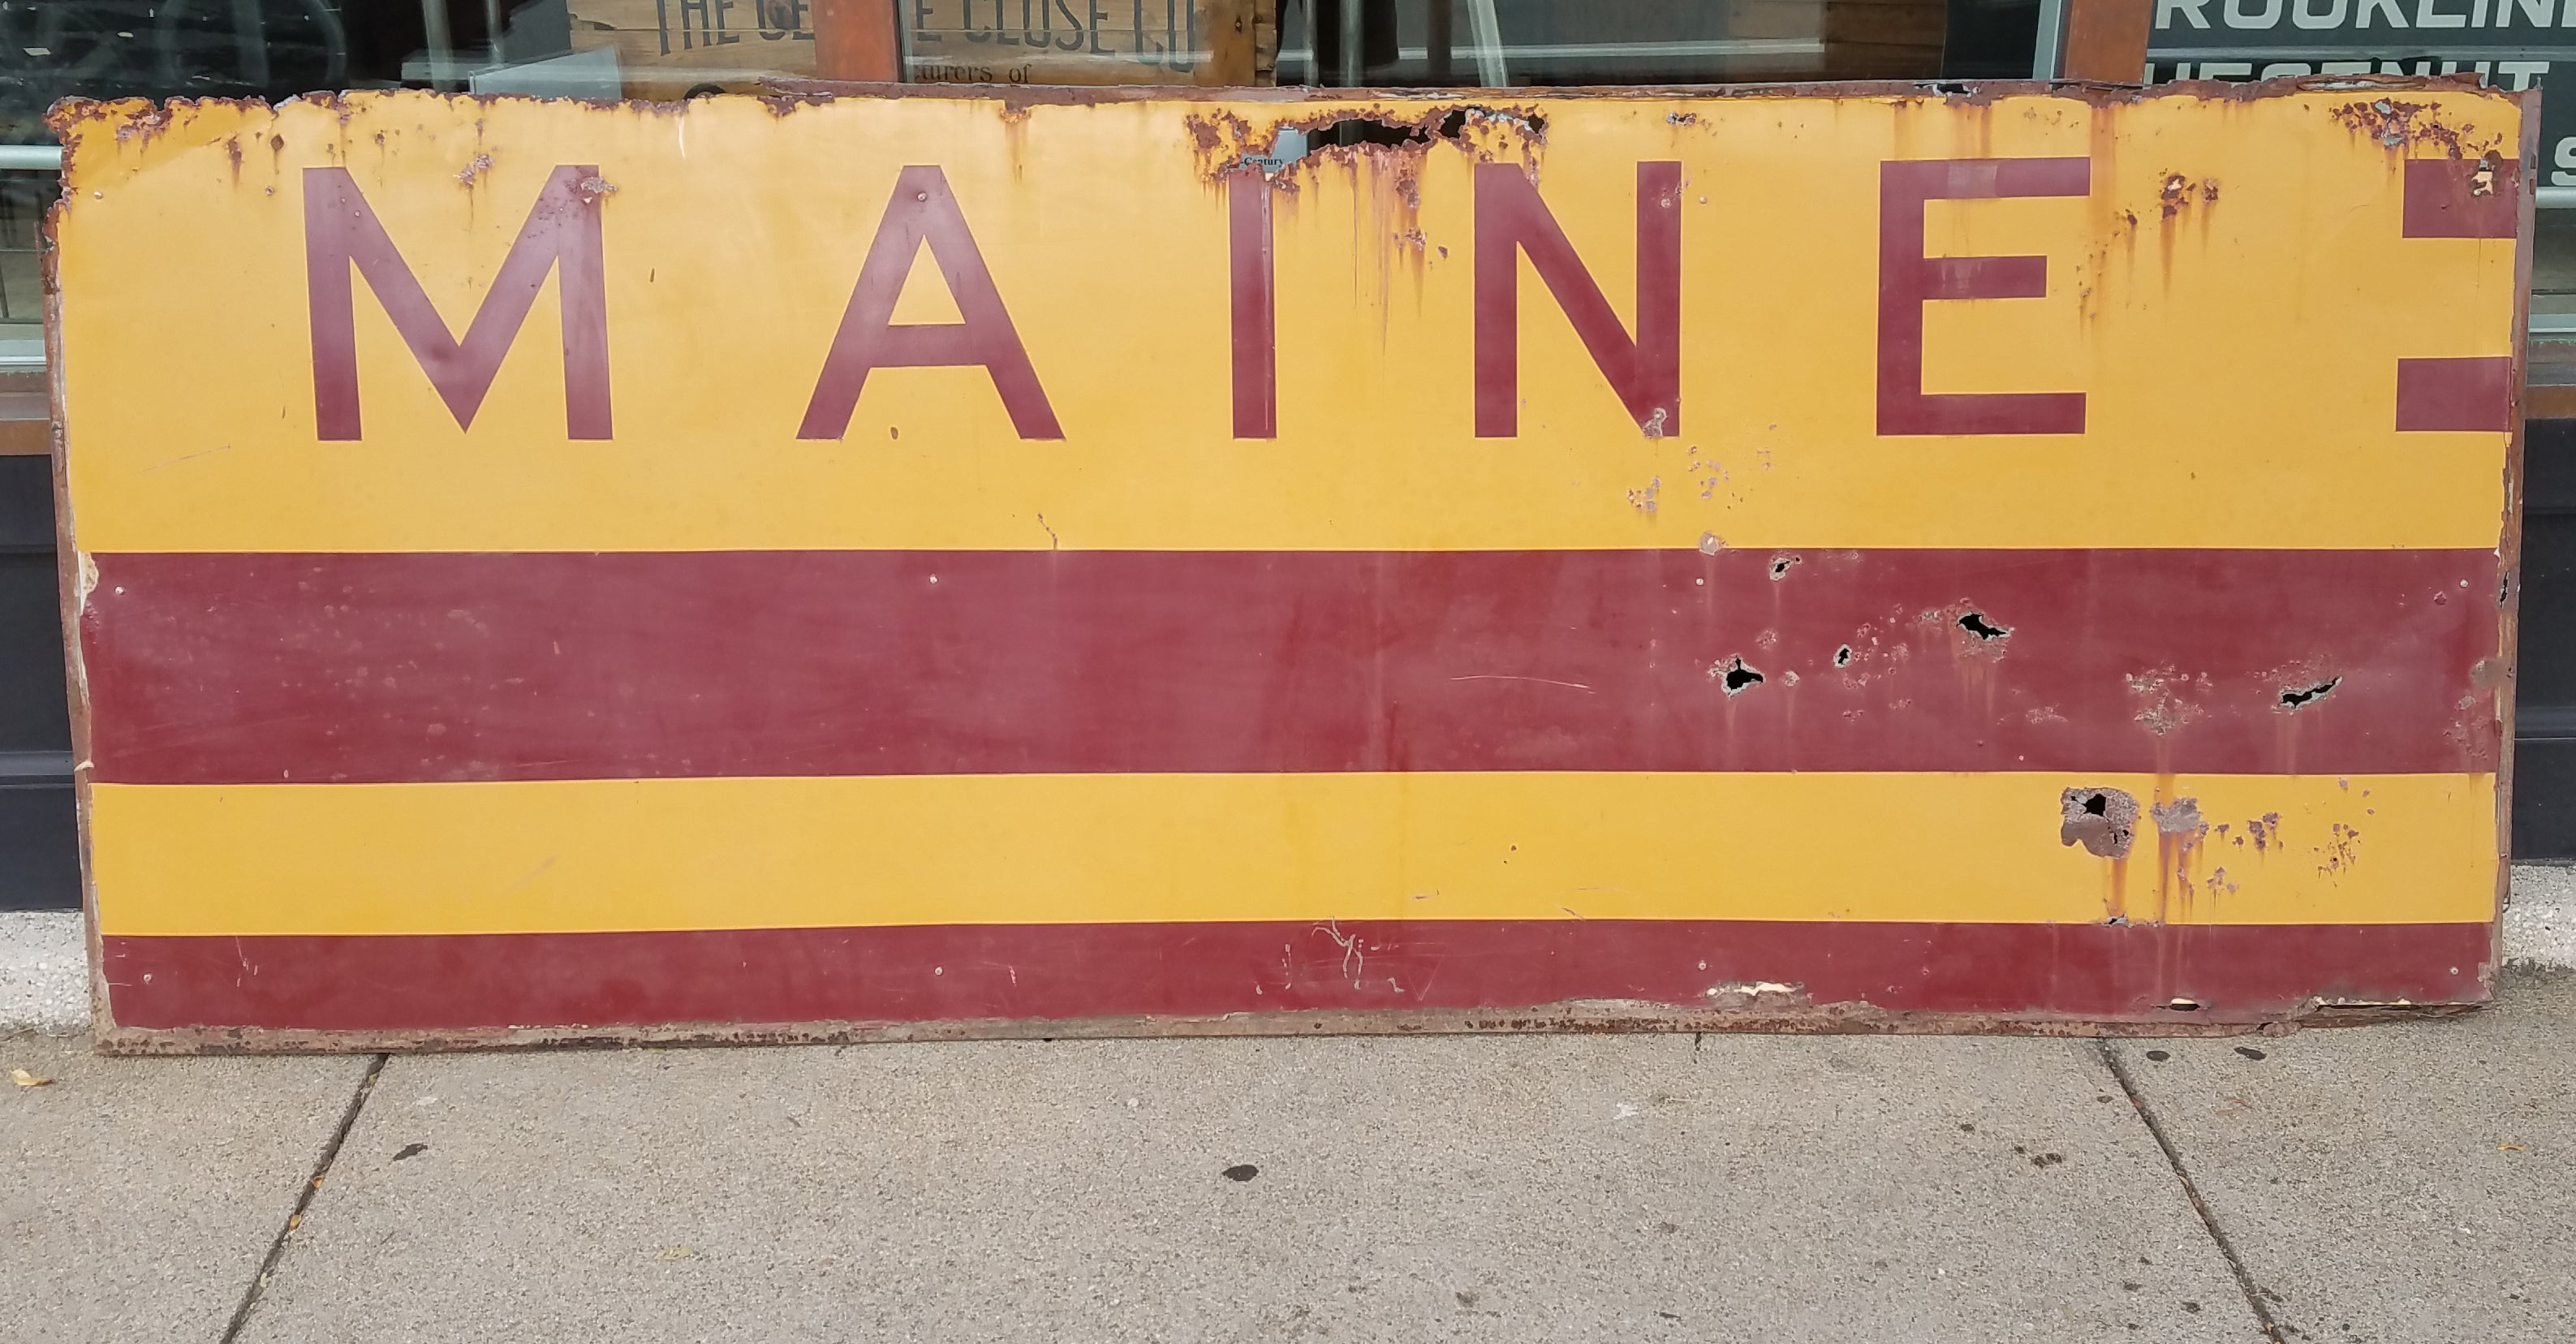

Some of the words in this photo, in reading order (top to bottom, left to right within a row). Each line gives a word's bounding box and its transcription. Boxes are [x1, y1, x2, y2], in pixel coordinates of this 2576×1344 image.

[2155, 0, 2576, 29] ROOKLIN
[1009, 64, 1032, 83] of
[302, 157, 2091, 441] MAINE
